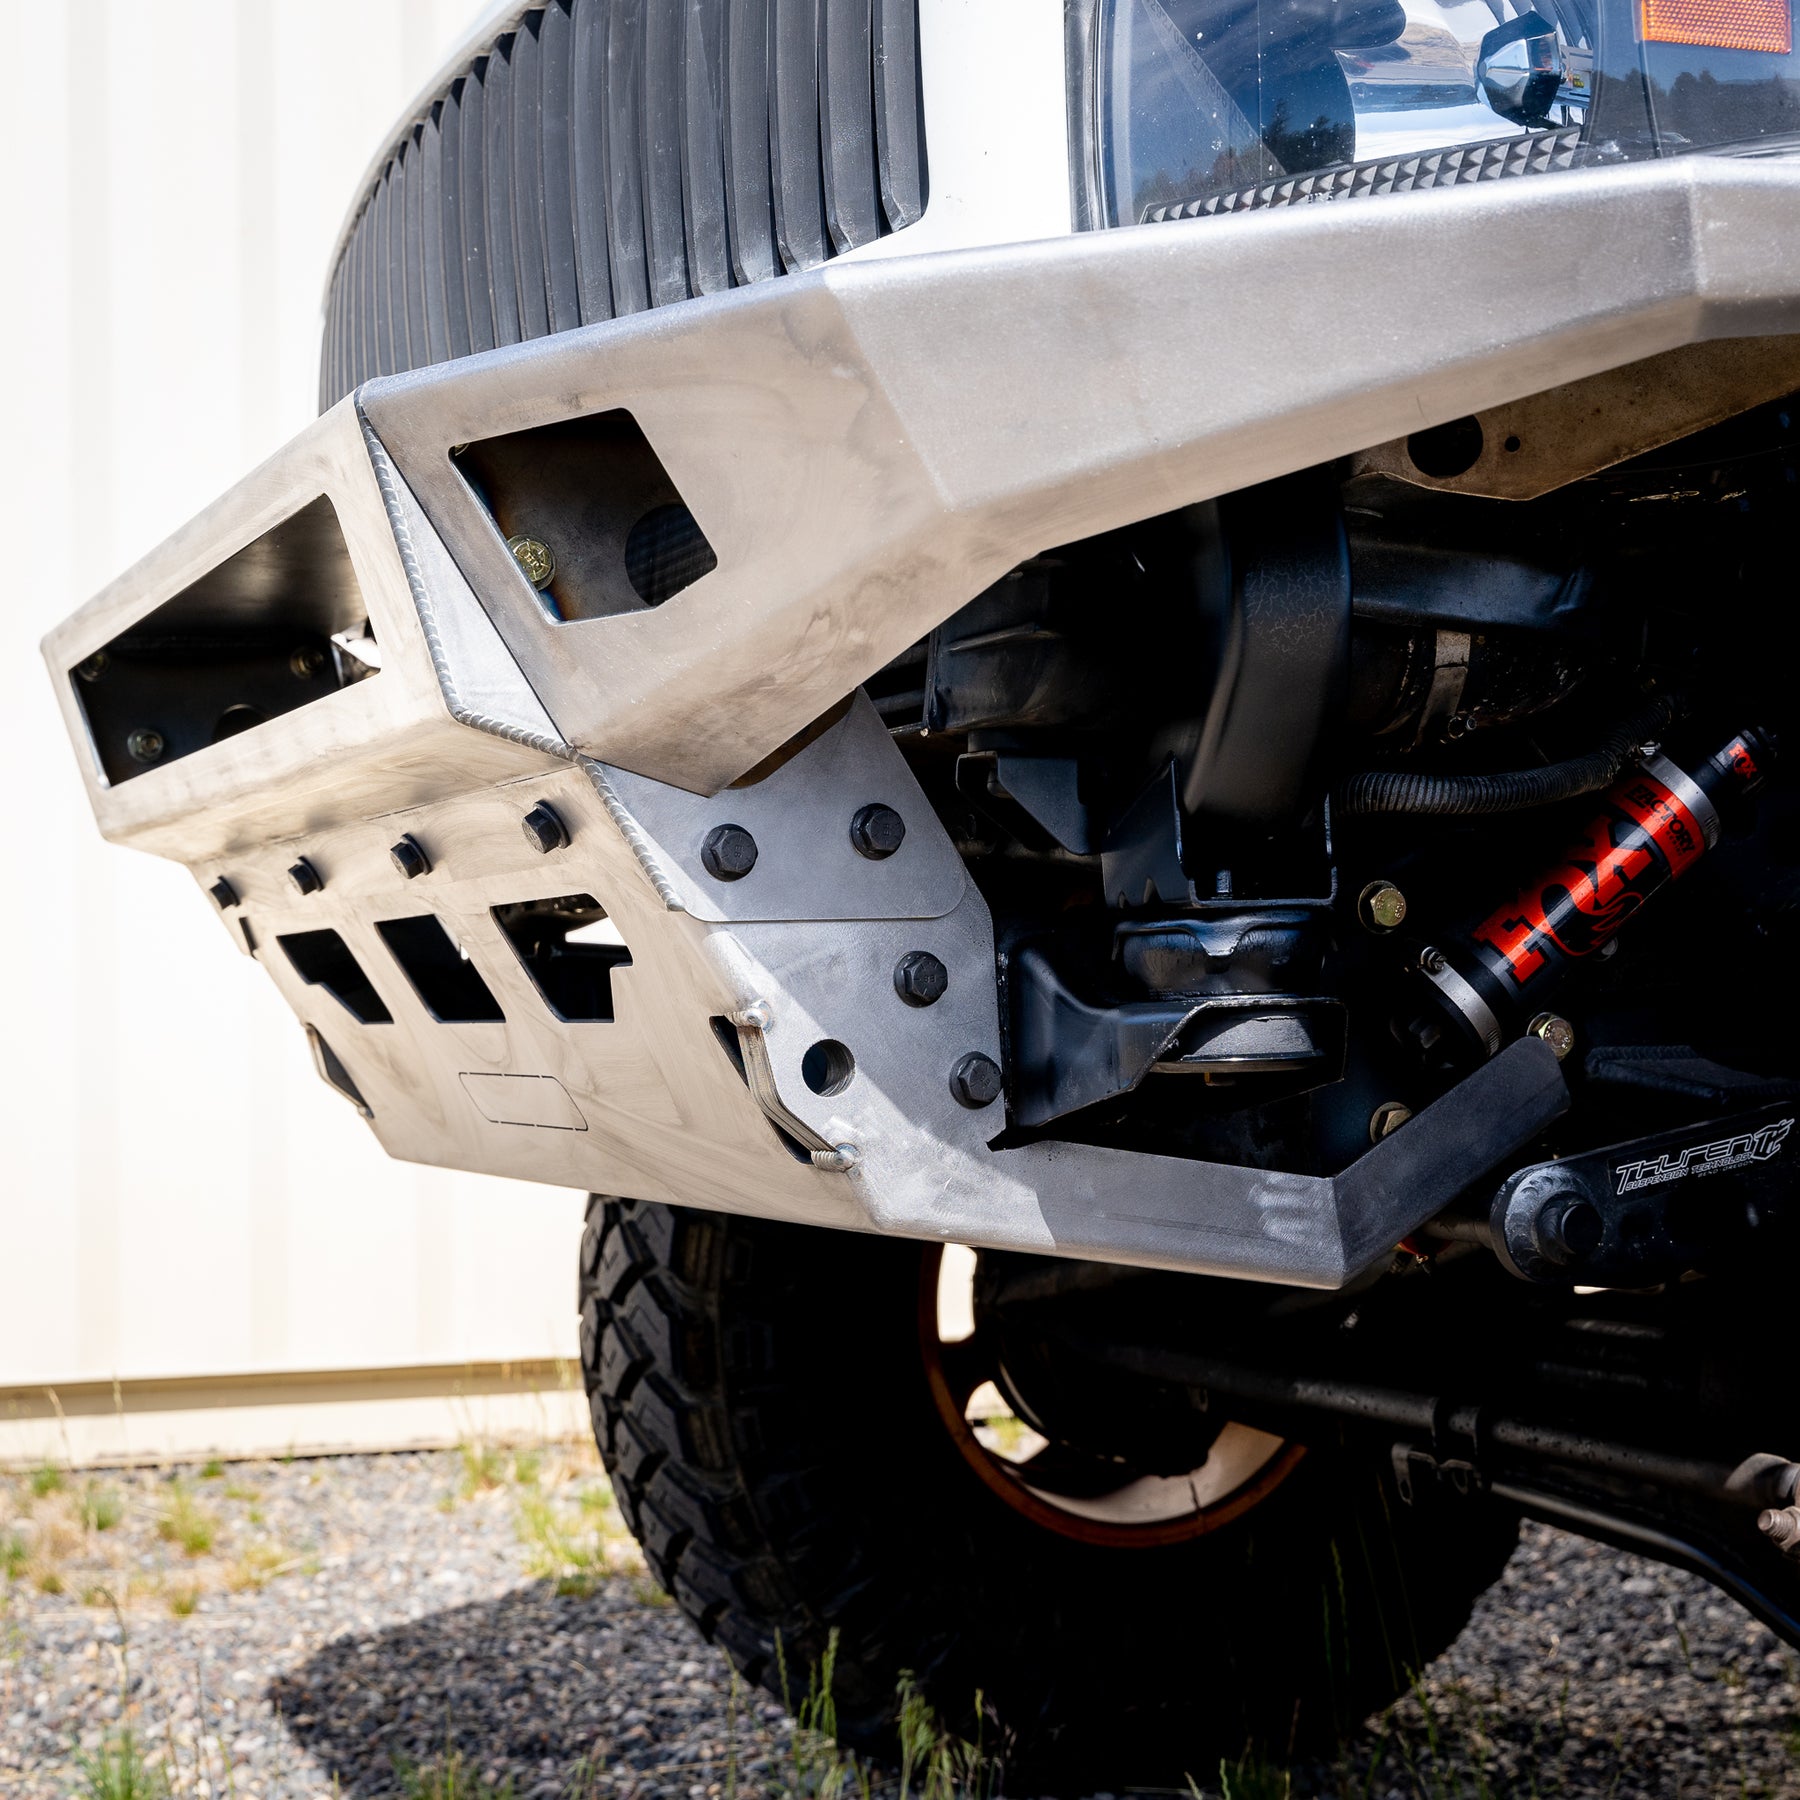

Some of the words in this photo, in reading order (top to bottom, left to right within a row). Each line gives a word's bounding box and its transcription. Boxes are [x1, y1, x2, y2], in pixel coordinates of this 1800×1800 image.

[1728, 743, 1758, 779] FOX
[1624, 784, 1695, 853] FACTORY
[1472, 814, 1653, 984] FOX
[1625, 1167, 1690, 1191] SUSPENSION
[1691, 1151, 1753, 1175] TECHNOLOGY
